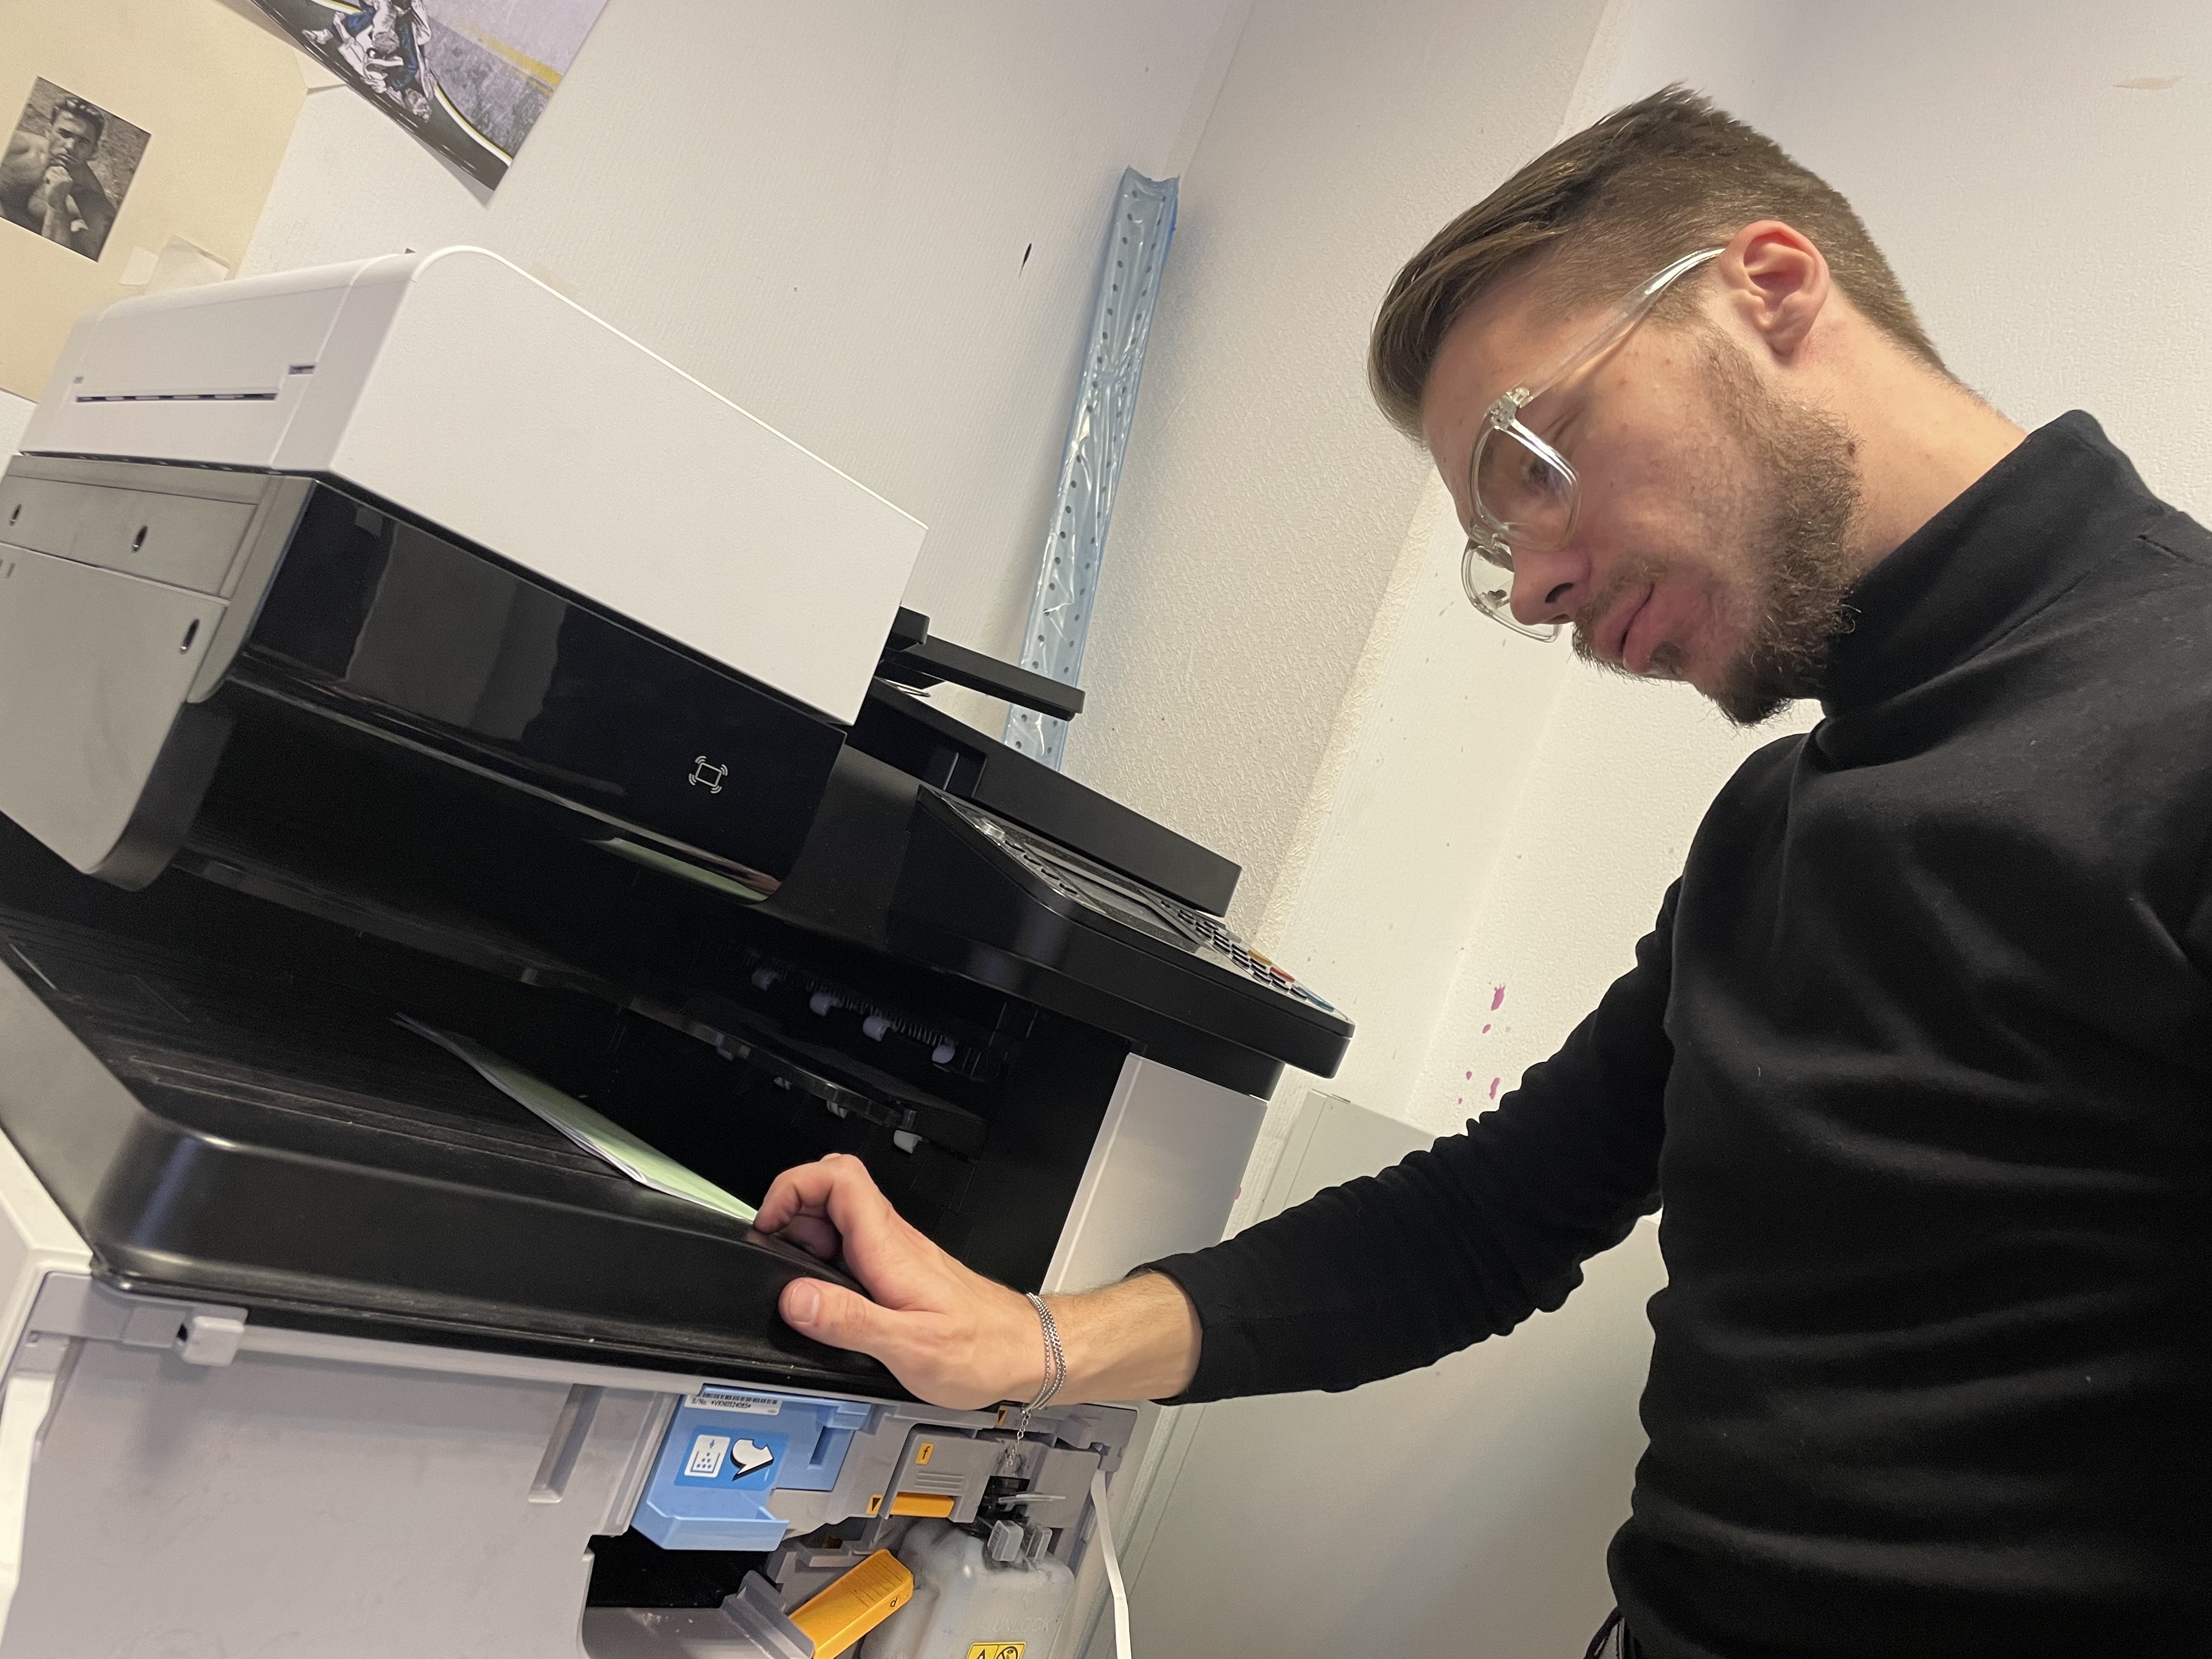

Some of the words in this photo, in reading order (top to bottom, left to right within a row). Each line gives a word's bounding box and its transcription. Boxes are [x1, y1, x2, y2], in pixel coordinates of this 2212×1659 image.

[922, 1446, 930, 1460] f
[890, 1596, 898, 1607] d
[994, 1617, 1052, 1632] UNLOCK
